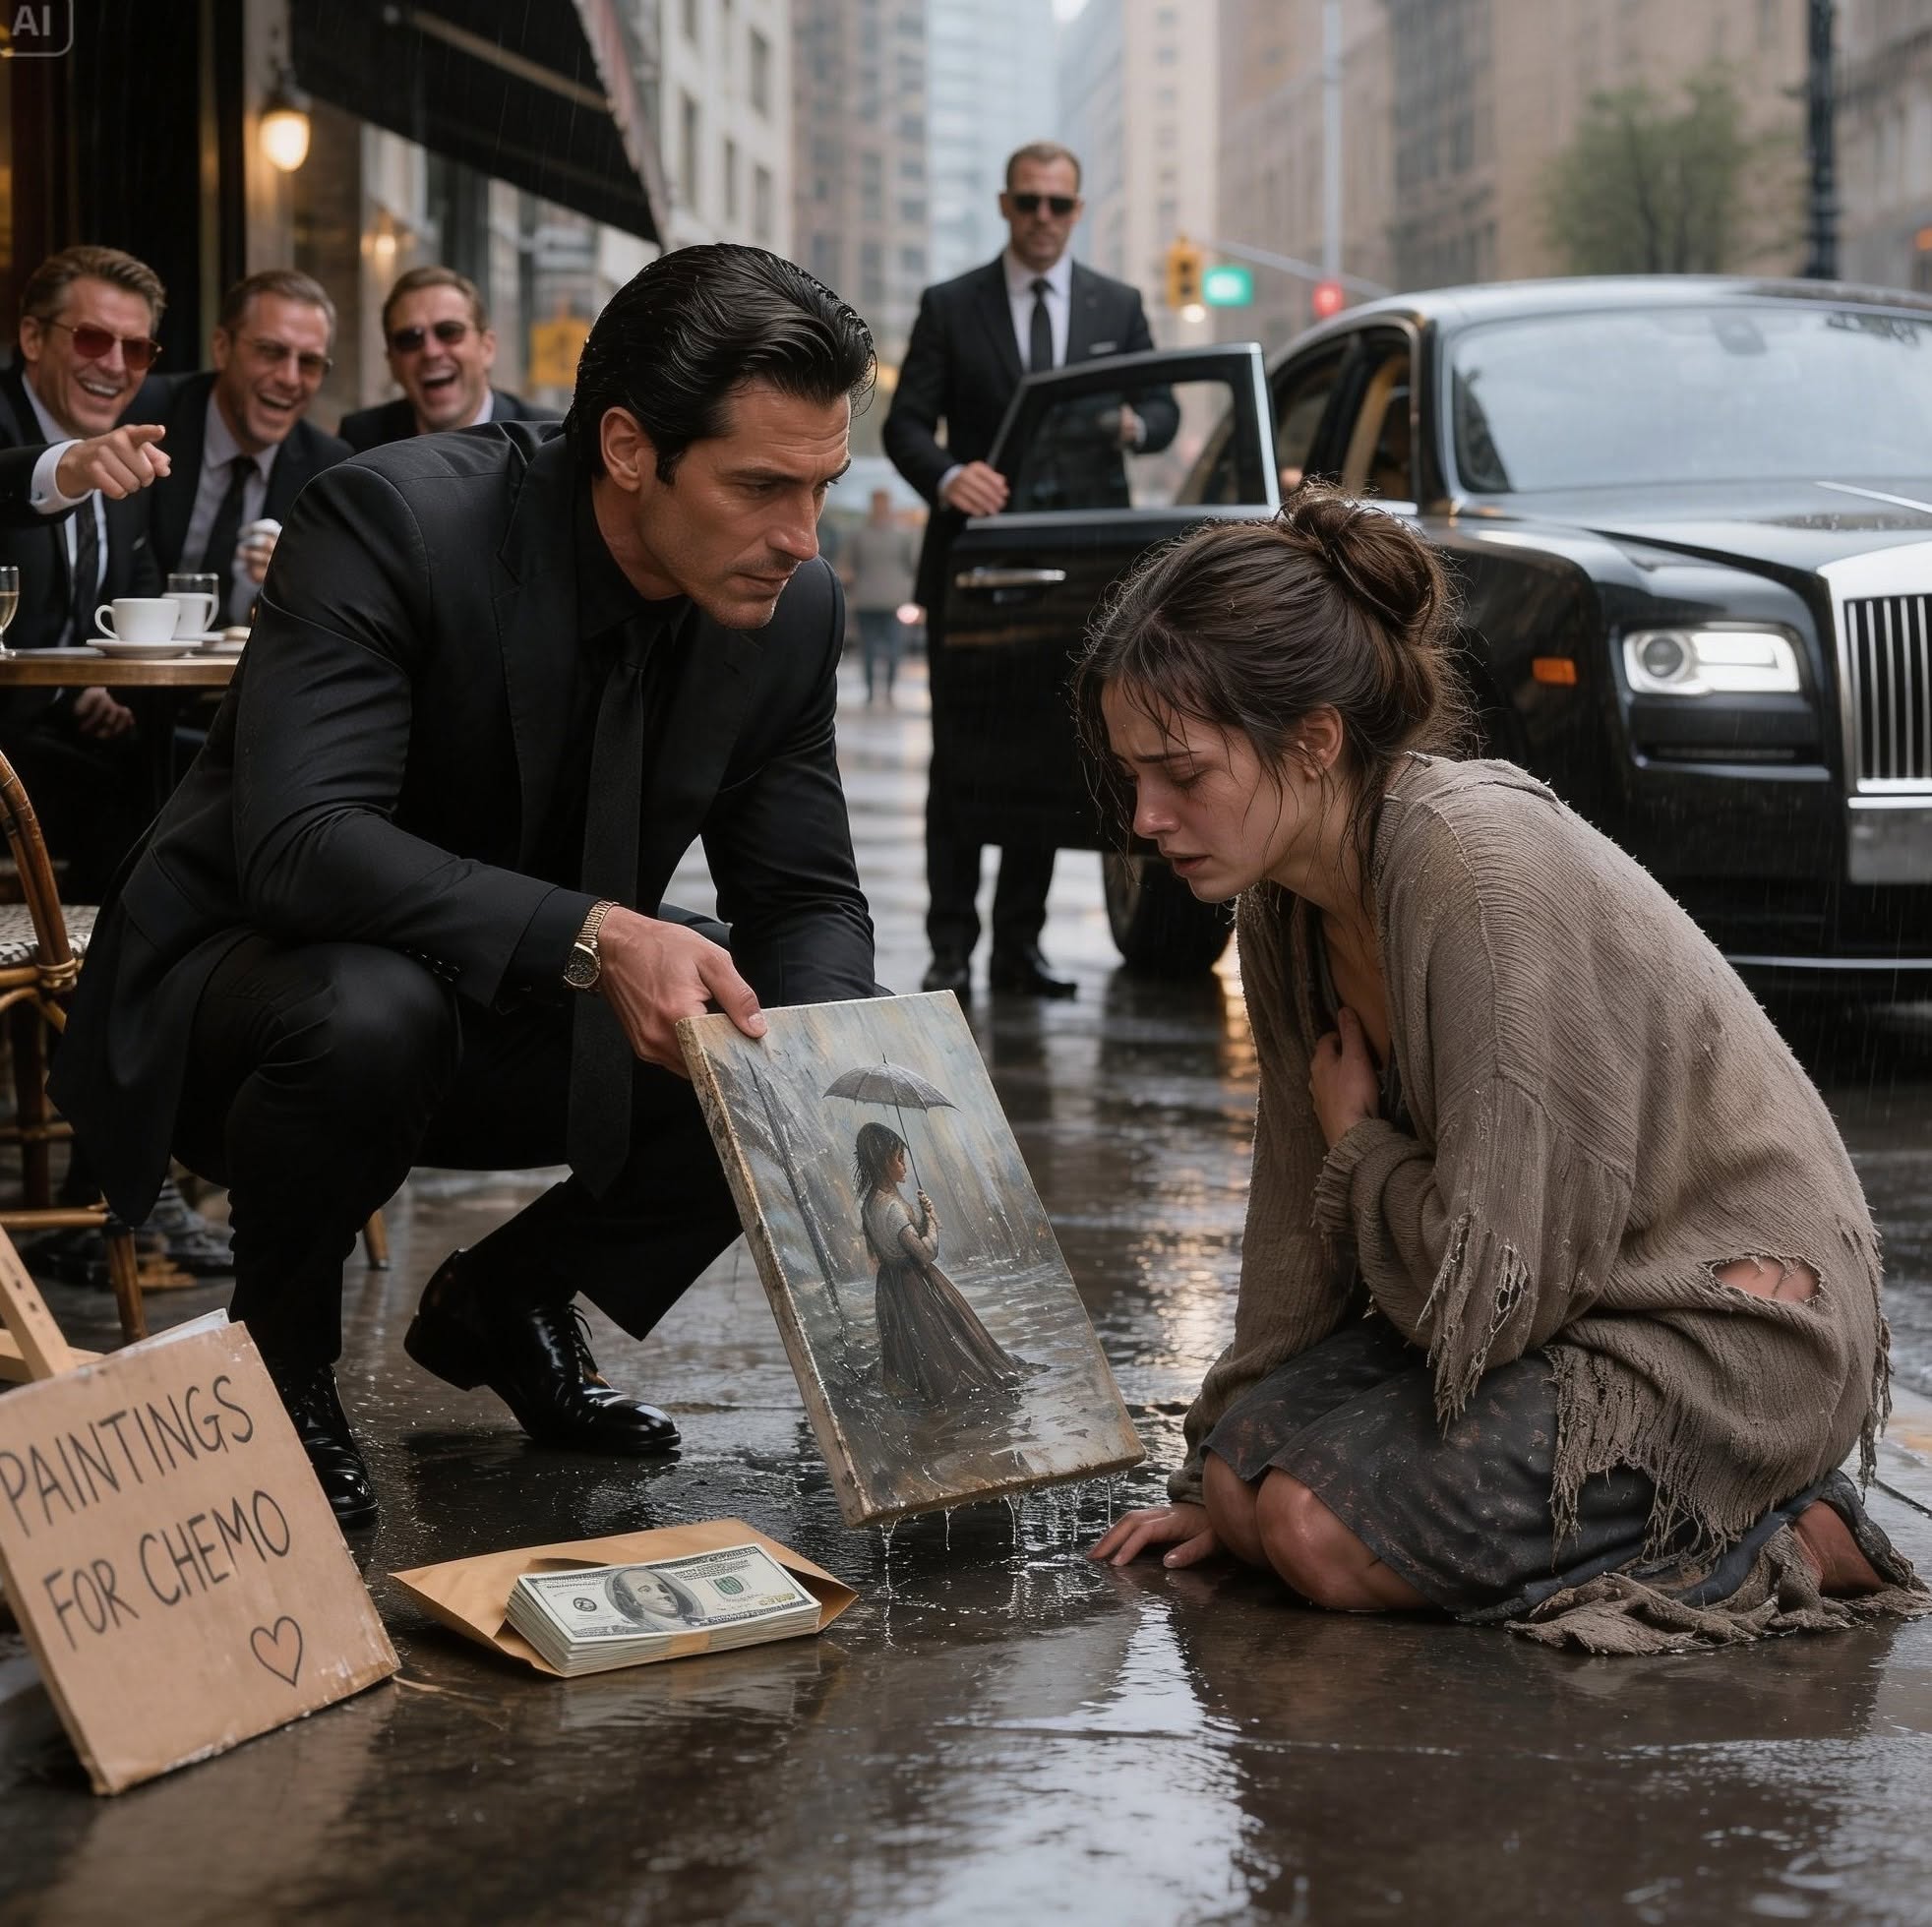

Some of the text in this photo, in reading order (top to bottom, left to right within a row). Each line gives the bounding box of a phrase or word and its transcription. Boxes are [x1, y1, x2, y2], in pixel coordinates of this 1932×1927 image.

[0, 1375, 254, 1537] PAINTINGS
[43, 1490, 290, 1653] FOR CHEMO
